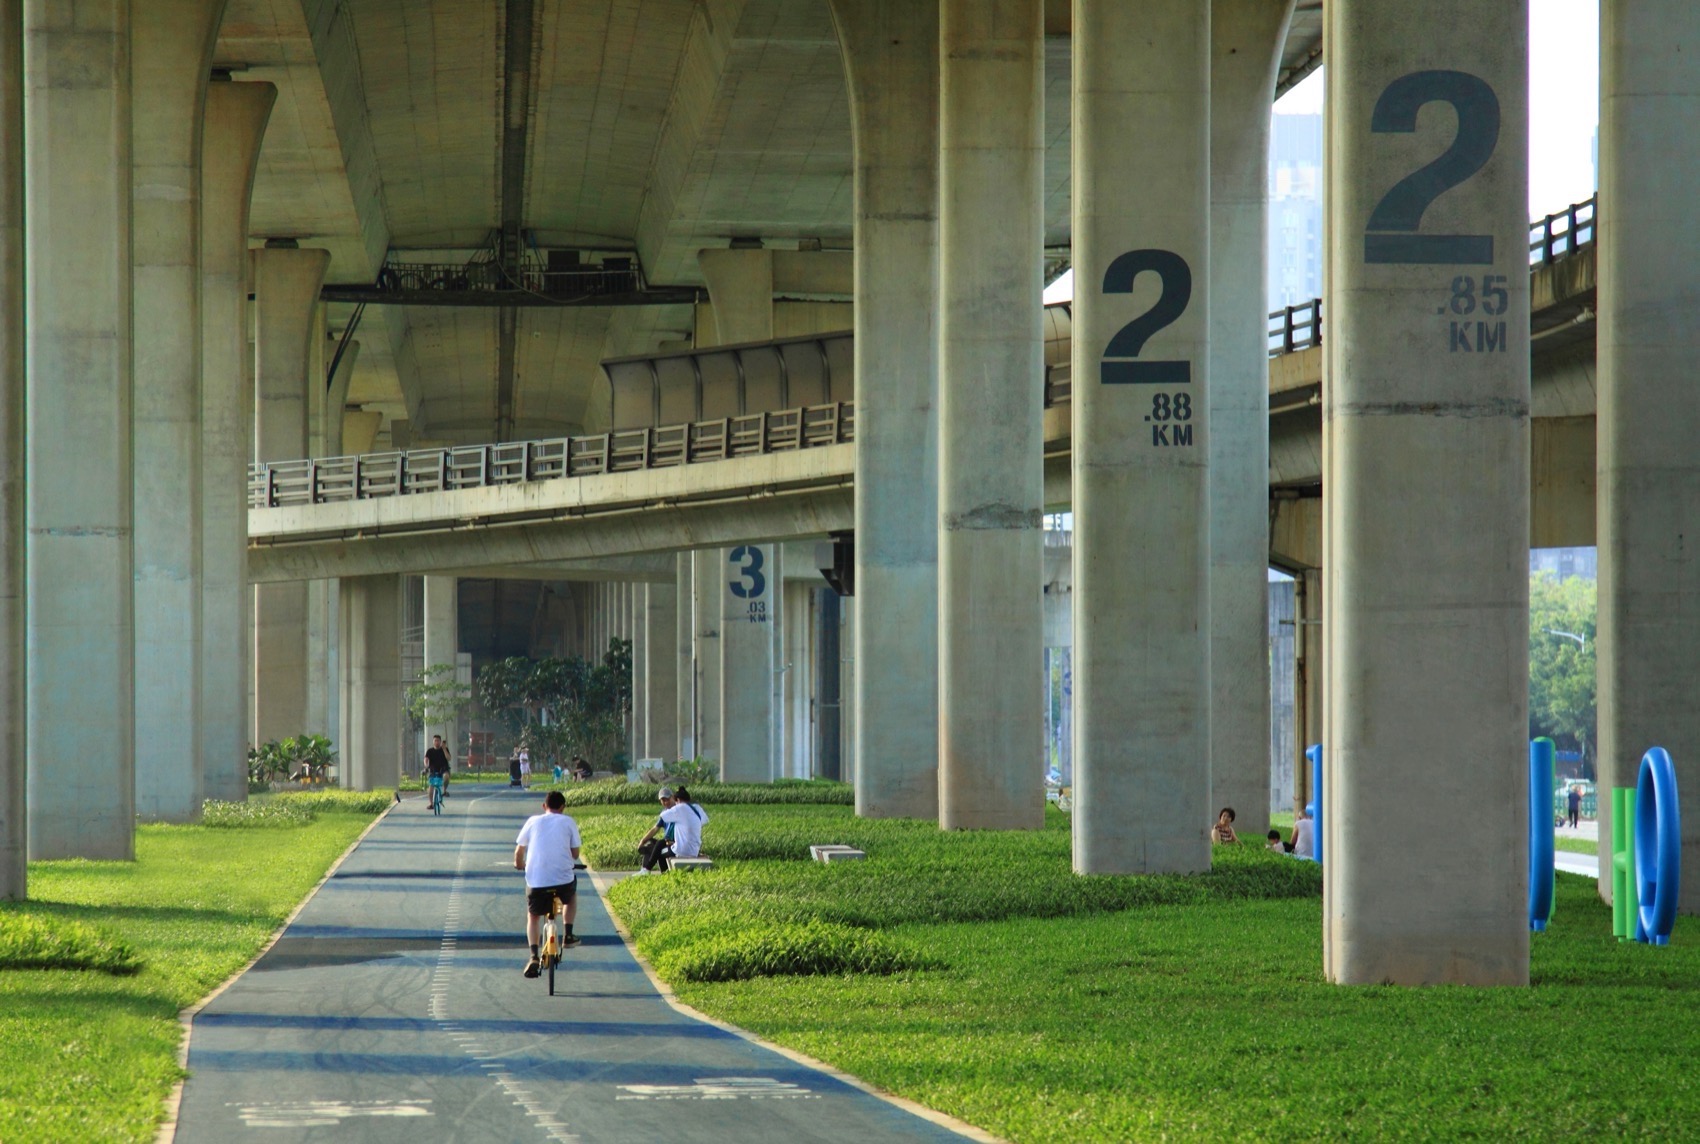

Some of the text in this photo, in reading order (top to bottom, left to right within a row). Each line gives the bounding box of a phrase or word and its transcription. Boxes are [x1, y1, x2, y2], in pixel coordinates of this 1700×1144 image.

[1364, 69, 1500, 264] 2
[1437, 275, 1508, 315] .85
[1101, 249, 1192, 384] 2
[1449, 321, 1507, 352] KM
[1144, 392, 1192, 421] .88
[1152, 424, 1193, 446] KM
[729, 545, 765, 598] 3
[746, 601, 766, 614] .03
[749, 614, 766, 623] KM
